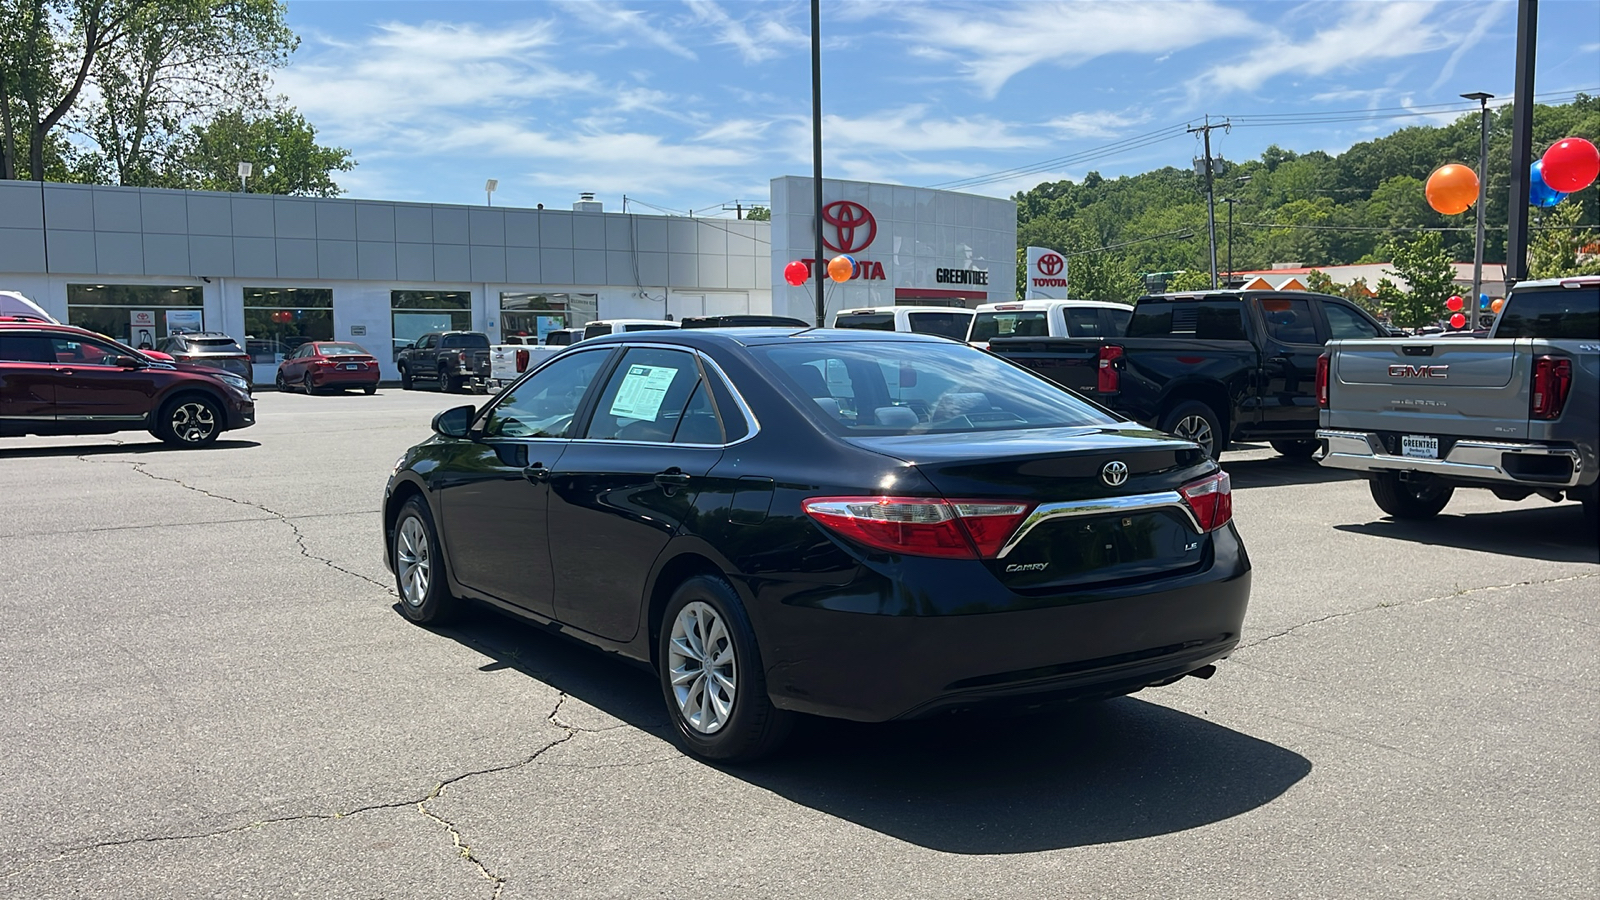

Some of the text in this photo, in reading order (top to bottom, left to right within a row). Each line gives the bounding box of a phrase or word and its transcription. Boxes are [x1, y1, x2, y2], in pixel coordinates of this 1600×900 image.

[801, 258, 886, 280] TOTA
[936, 267, 988, 285] GREENTREE
[1032, 278, 1067, 287] TOYOTA
[1388, 364, 1449, 379] GMC
[1403, 439, 1437, 449] GREENTREE
[1184, 542, 1198, 551] LE
